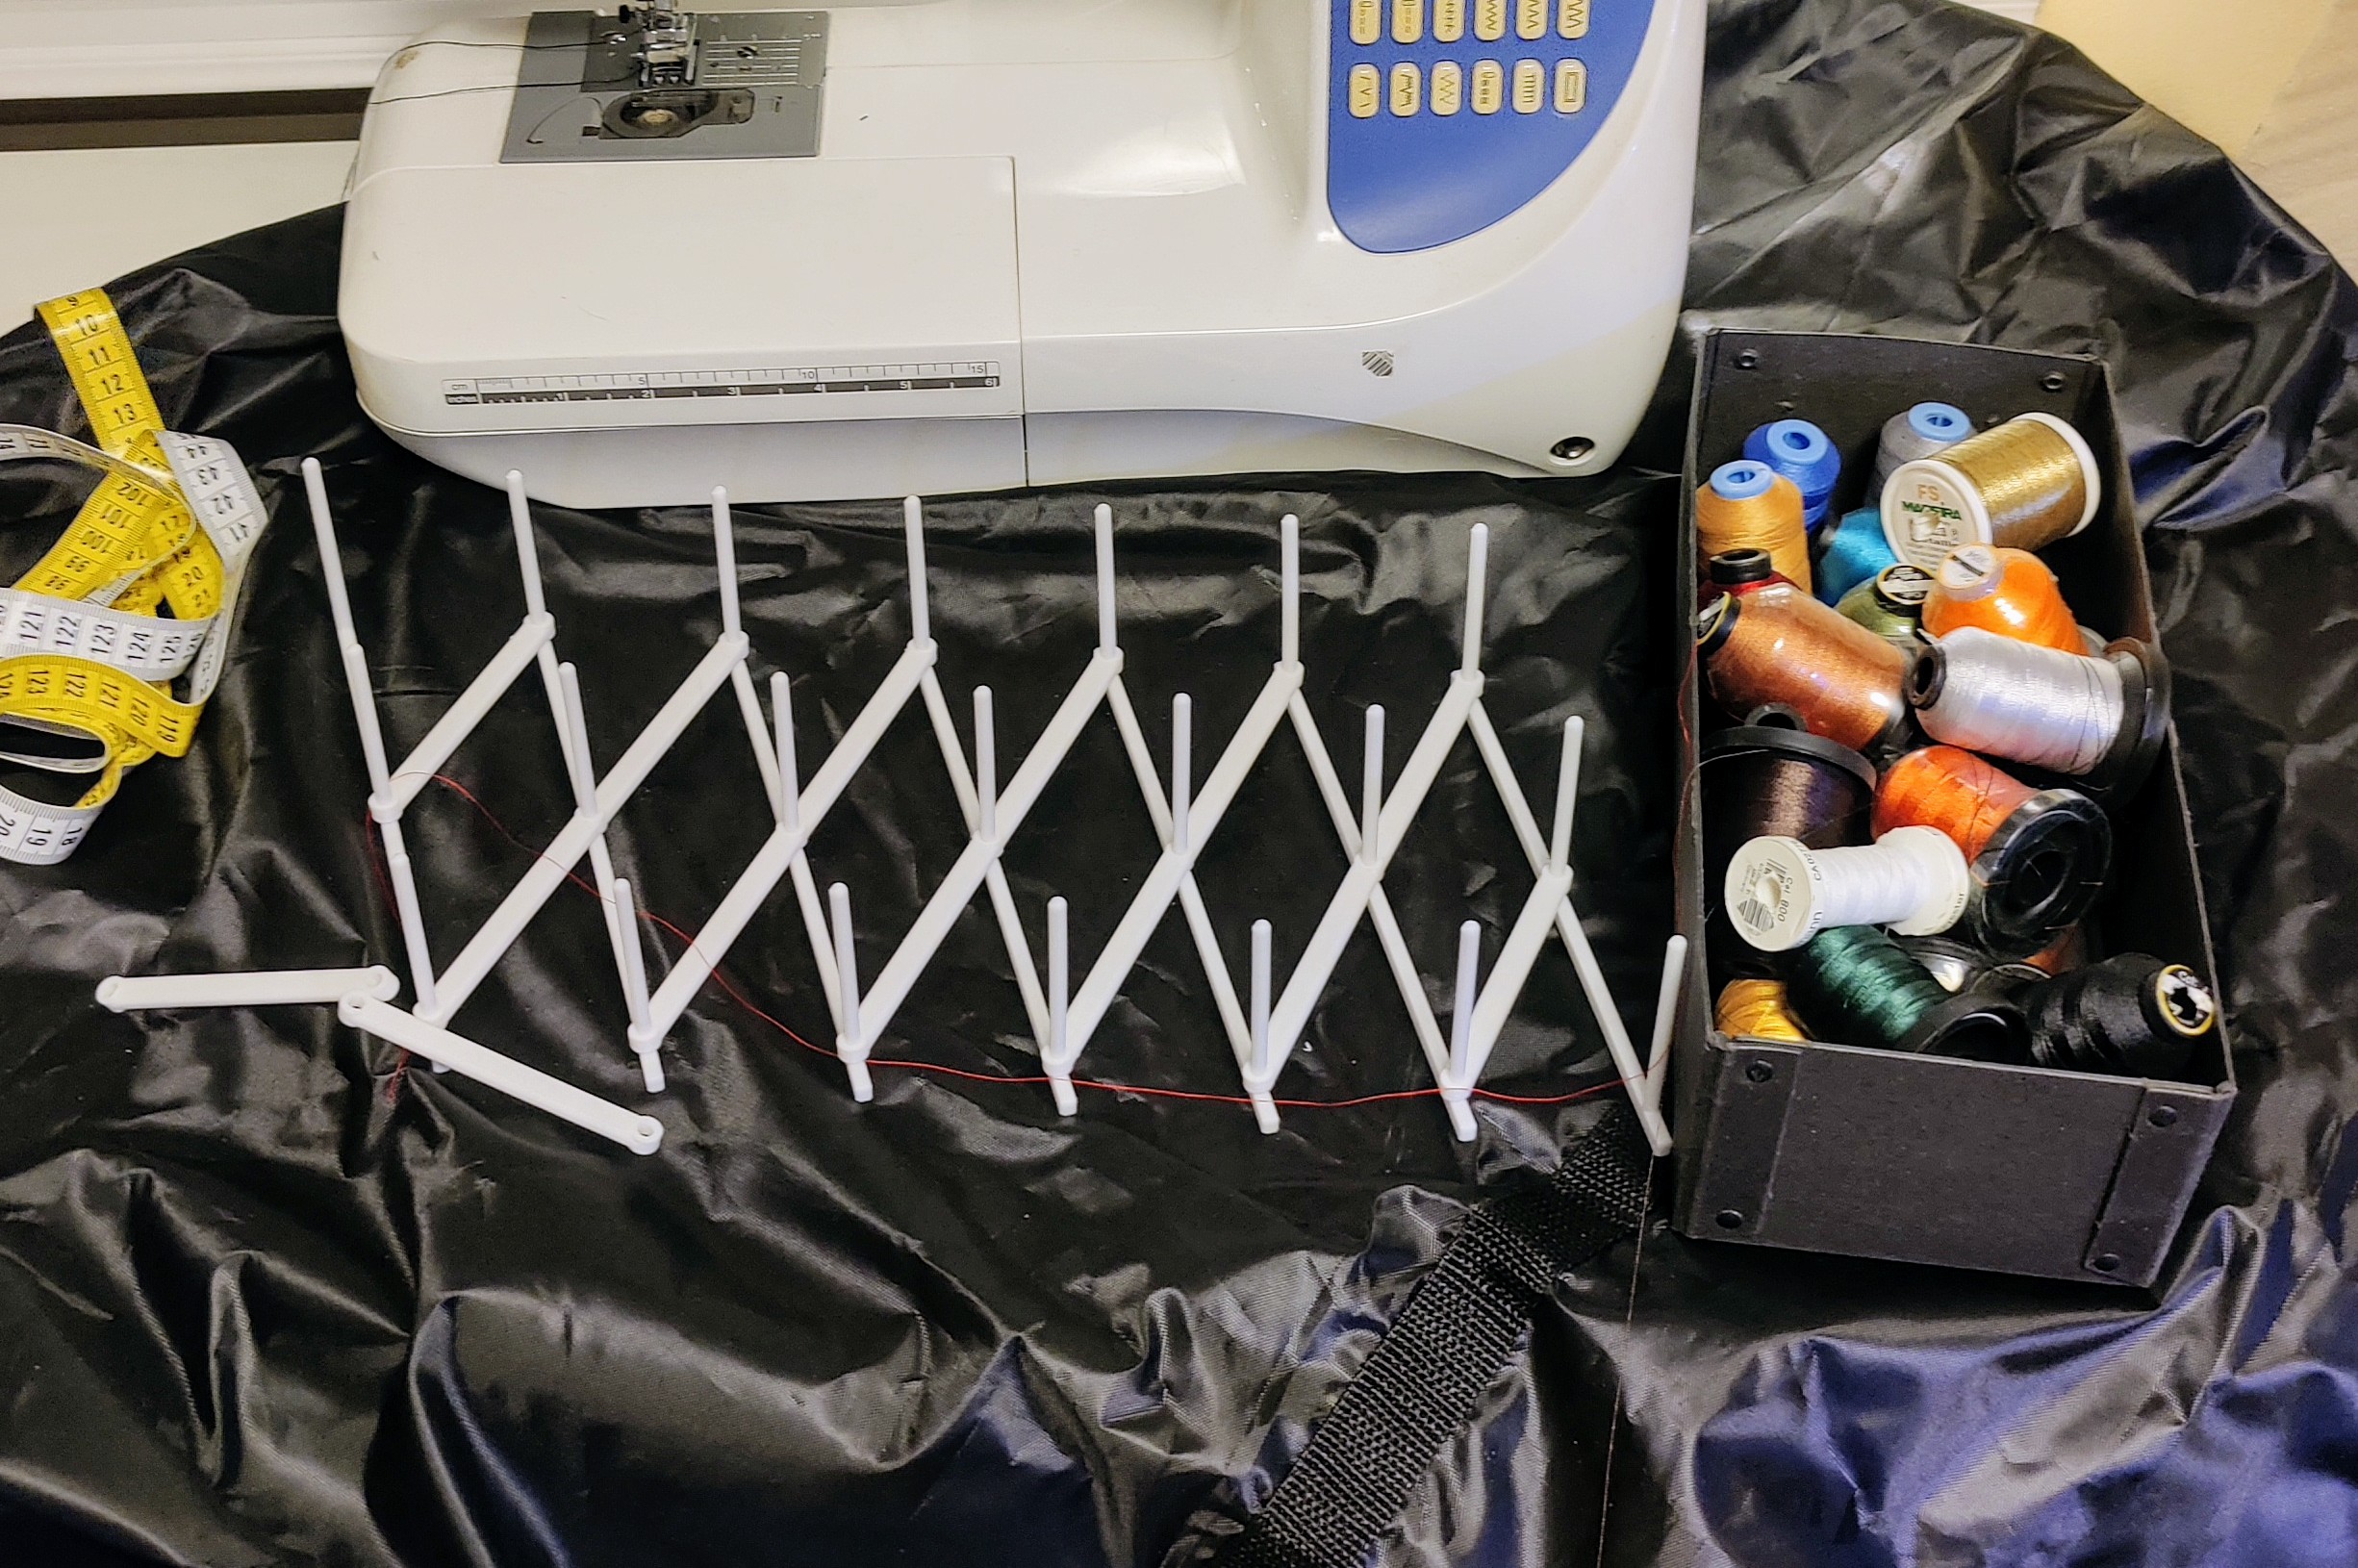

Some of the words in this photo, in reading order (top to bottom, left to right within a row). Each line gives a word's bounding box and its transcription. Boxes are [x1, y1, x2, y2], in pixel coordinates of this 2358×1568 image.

[75, 315, 98, 336] 10
[88, 346, 111, 366] 11
[801, 370, 816, 380] 10
[970, 366, 984, 374] 15
[100, 374, 124, 394] 12
[113, 403, 138, 424] 13
[116, 482, 150, 506] 102
[1917, 484, 1940, 501] FS
[99, 504, 132, 529] 101
[81, 530, 113, 554] 100
[19, 611, 44, 640] 121
[56, 616, 80, 647] 122
[90, 623, 115, 655] 123
[127, 631, 152, 662] 124
[160, 635, 182, 664] 125
[27, 670, 50, 694] 123
[65, 672, 88, 698] 122
[100, 681, 121, 709] 121
[130, 695, 151, 727] 120
[157, 714, 180, 743] 119
[27, 828, 53, 847] 19
[62, 827, 83, 846] 18
[1777, 898, 1789, 923] 800
